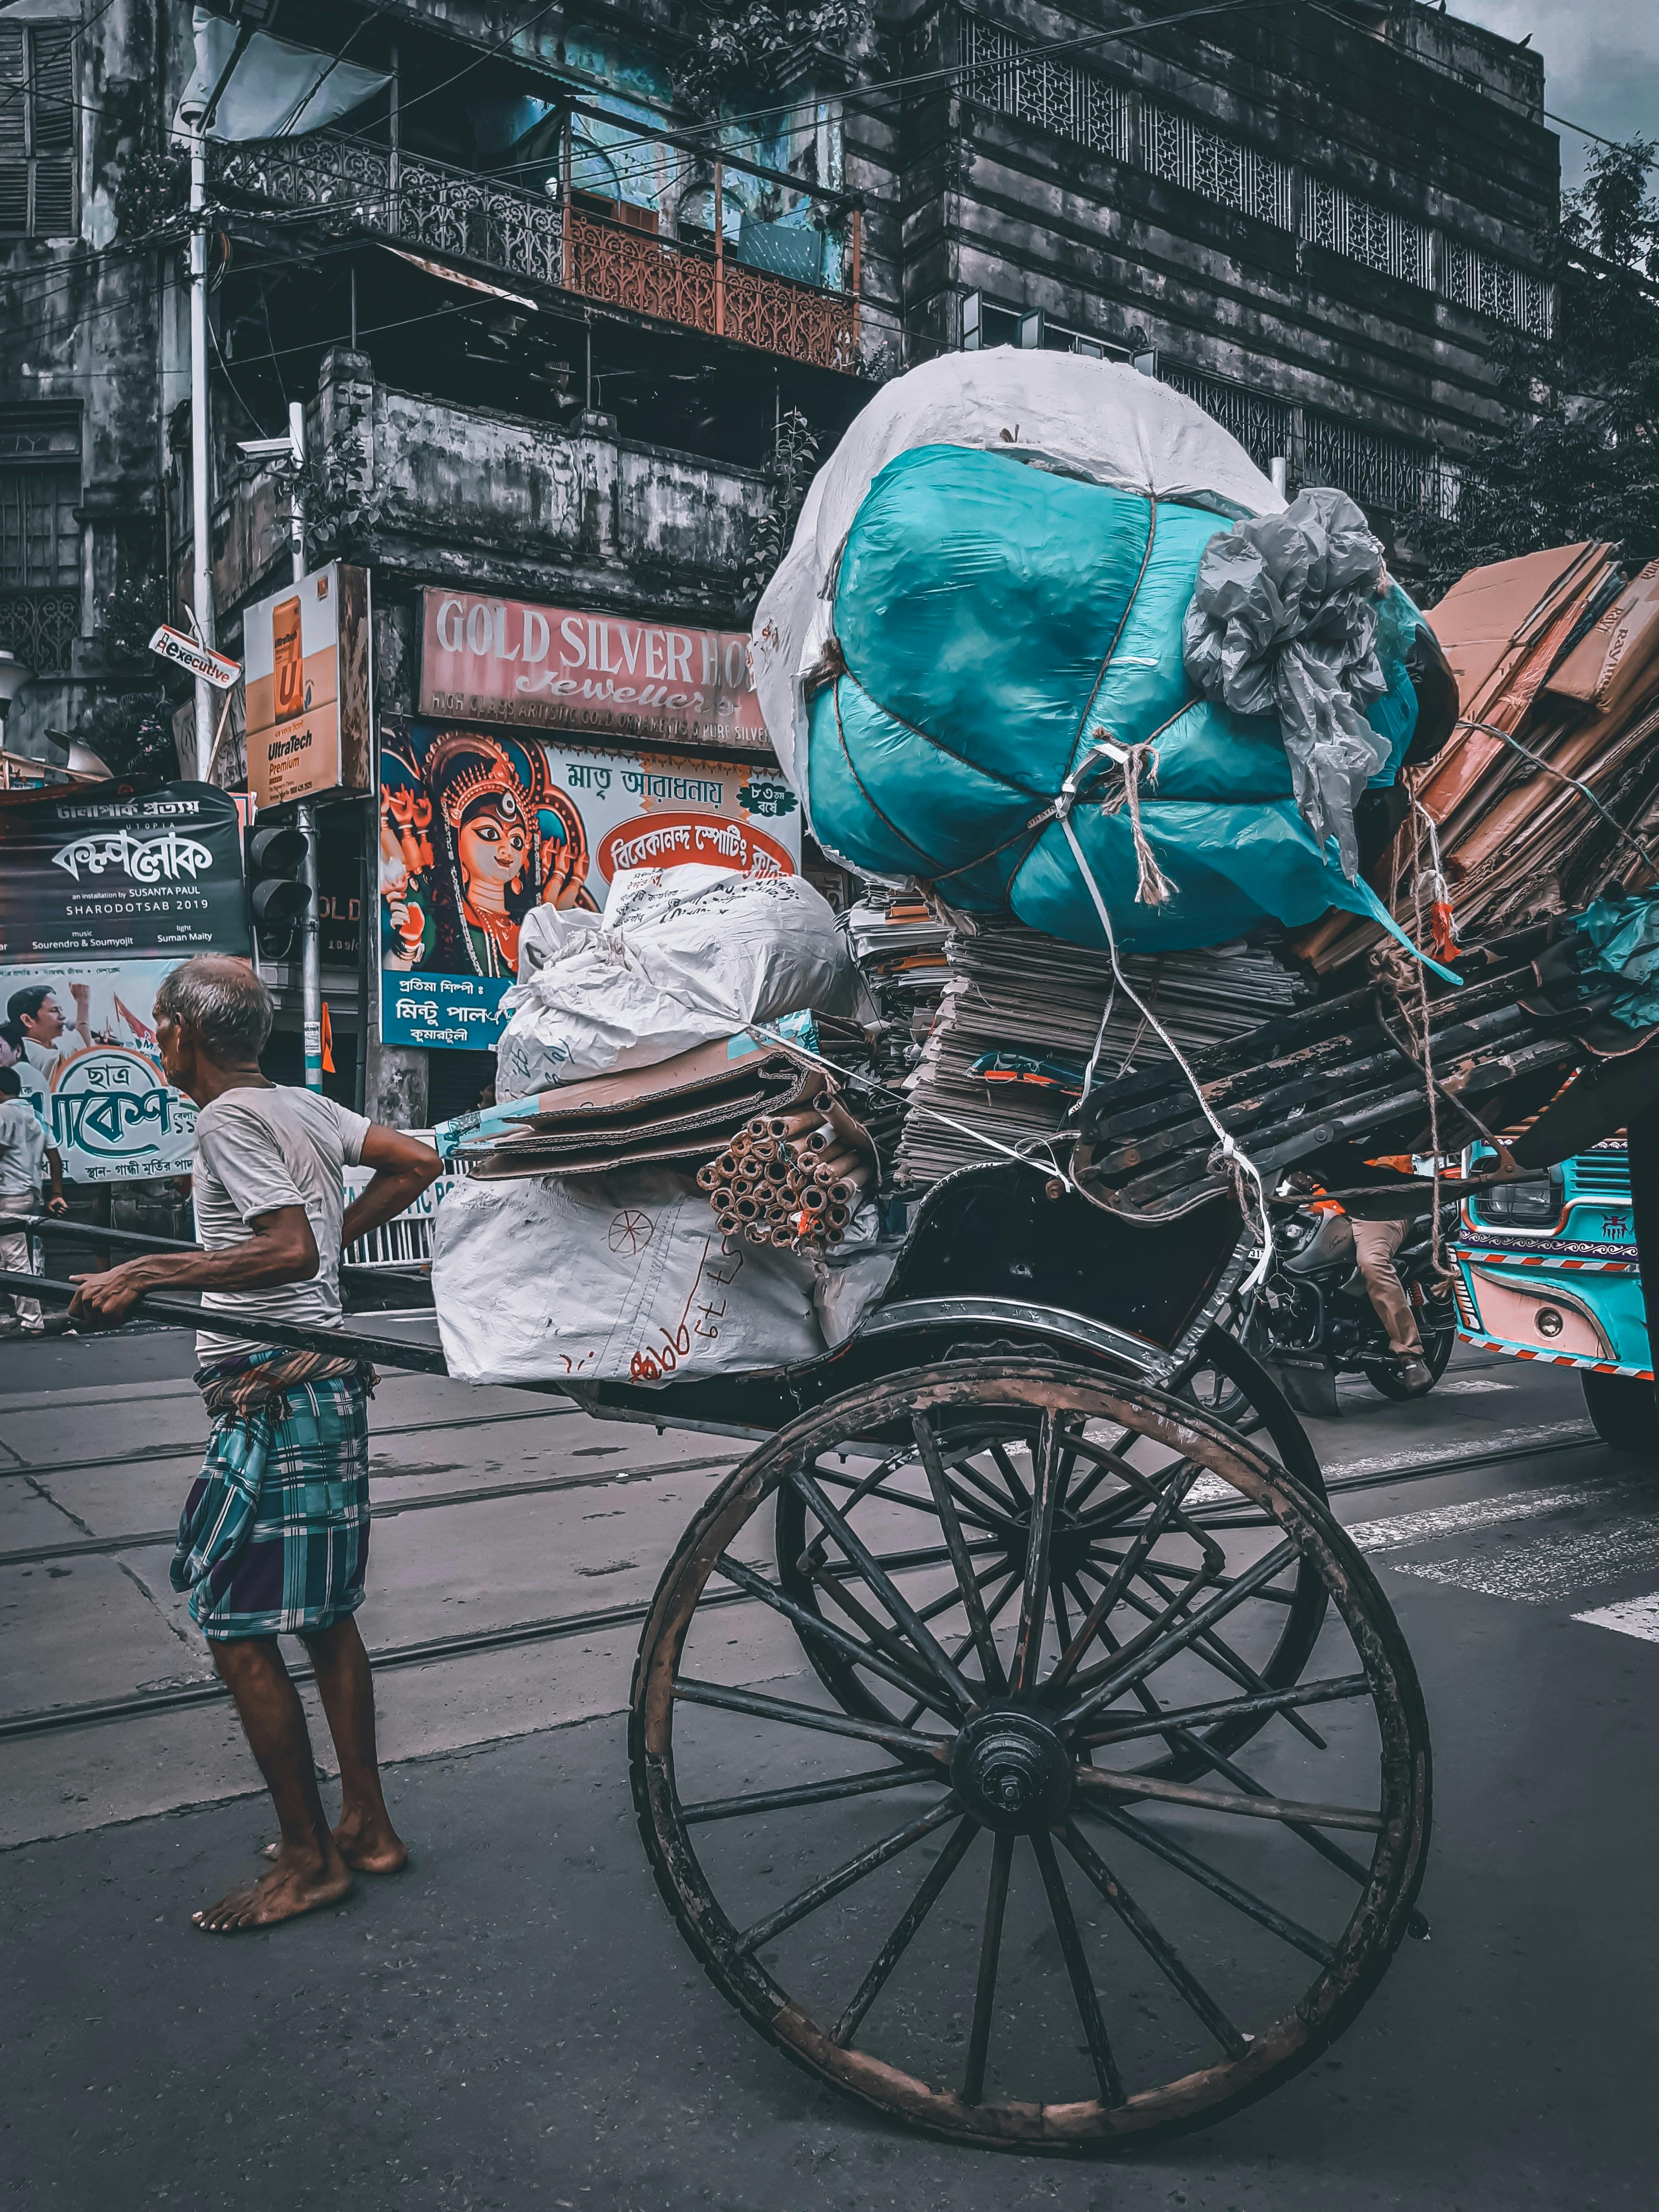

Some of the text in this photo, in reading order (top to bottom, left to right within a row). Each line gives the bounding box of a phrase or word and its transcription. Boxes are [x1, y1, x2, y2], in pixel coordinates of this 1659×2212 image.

[436, 599, 751, 690] GOLD SILVER HO
[432, 693, 465, 711] HIGH
[470, 695, 515, 715] CLASS
[519, 704, 576, 722] ARTISTIC
[582, 710, 614, 726] GOLD
[703, 724, 730, 738] PURE
[268, 730, 312, 761] UltraTech
[269, 757, 299, 776] Premium
[566, 764, 724, 809] মাতৃ আরাধনায়
[757, 800, 777, 814] বর্ষে
[611, 826, 691, 871] বিবেকানন্দ
[129, 887, 173, 898] SUSANTA
[176, 886, 200, 895] PAUL
[67, 899, 209, 915] SHARODOTSAB 2019
[32, 937, 134, 950] Sourendro & Soumyojit
[157, 932, 212, 942] Suman Maity
[399, 978, 436, 992] প্রতিমা
[441, 980, 474, 995] শিল্পী
[396, 998, 487, 1026] মিন্টু পাল
[410, 1028, 468, 1044] কুমারটুলী
[84, 1064, 132, 1090] ছাত্র
[115, 1163, 139, 1176] গান্ধী
[144, 1158, 171, 1176] মূর্তির
